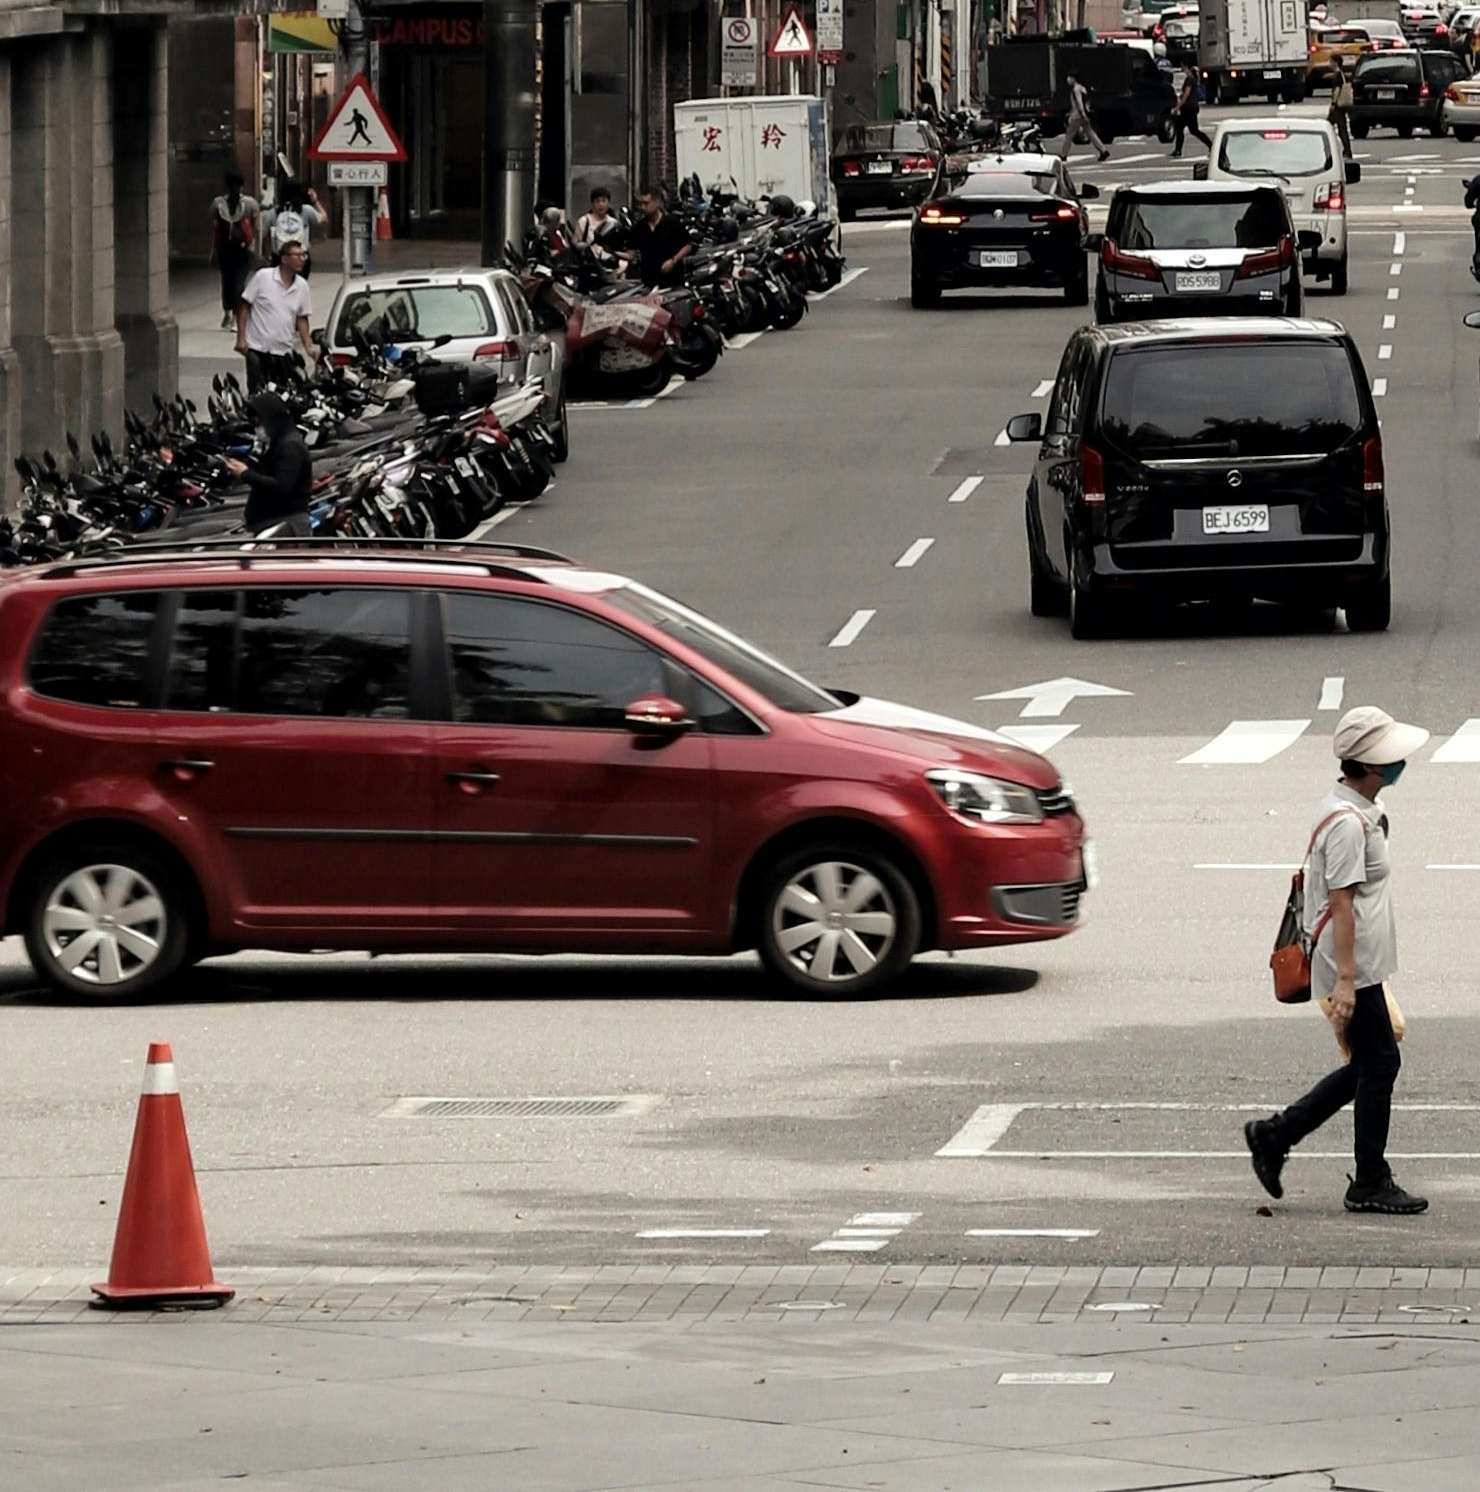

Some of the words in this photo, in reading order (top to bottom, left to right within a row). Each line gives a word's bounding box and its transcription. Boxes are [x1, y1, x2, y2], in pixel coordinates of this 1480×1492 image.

[376, 19, 474, 46] CAMPUS
[331, 166, 383, 181] 當心行人
[1205, 510, 1267, 529] BEJ-6599
